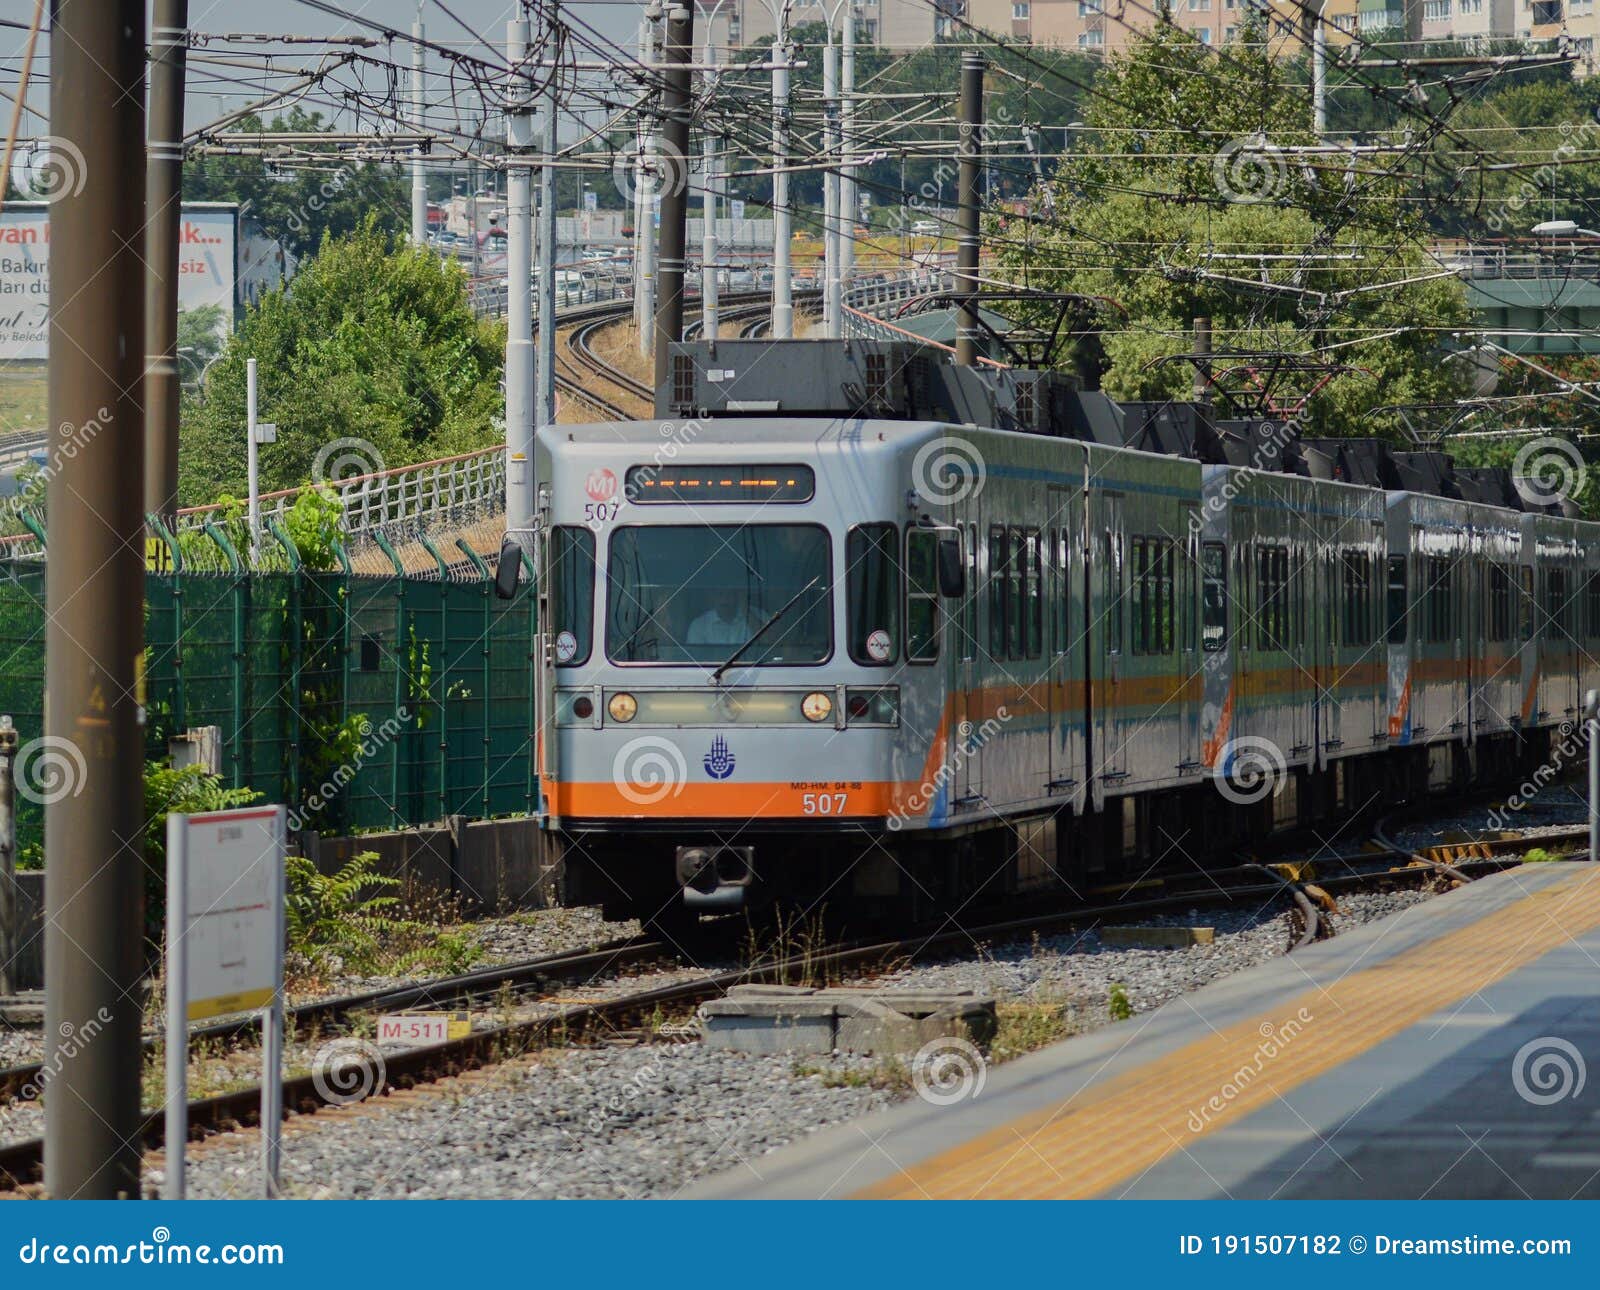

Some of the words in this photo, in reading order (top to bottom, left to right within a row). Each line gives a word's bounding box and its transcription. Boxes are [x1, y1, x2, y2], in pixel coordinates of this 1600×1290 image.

[2, 258, 49, 273] Bakır
[585, 503, 619, 521] 507
[803, 793, 847, 814] 507
[383, 1023, 442, 1038] M-511
